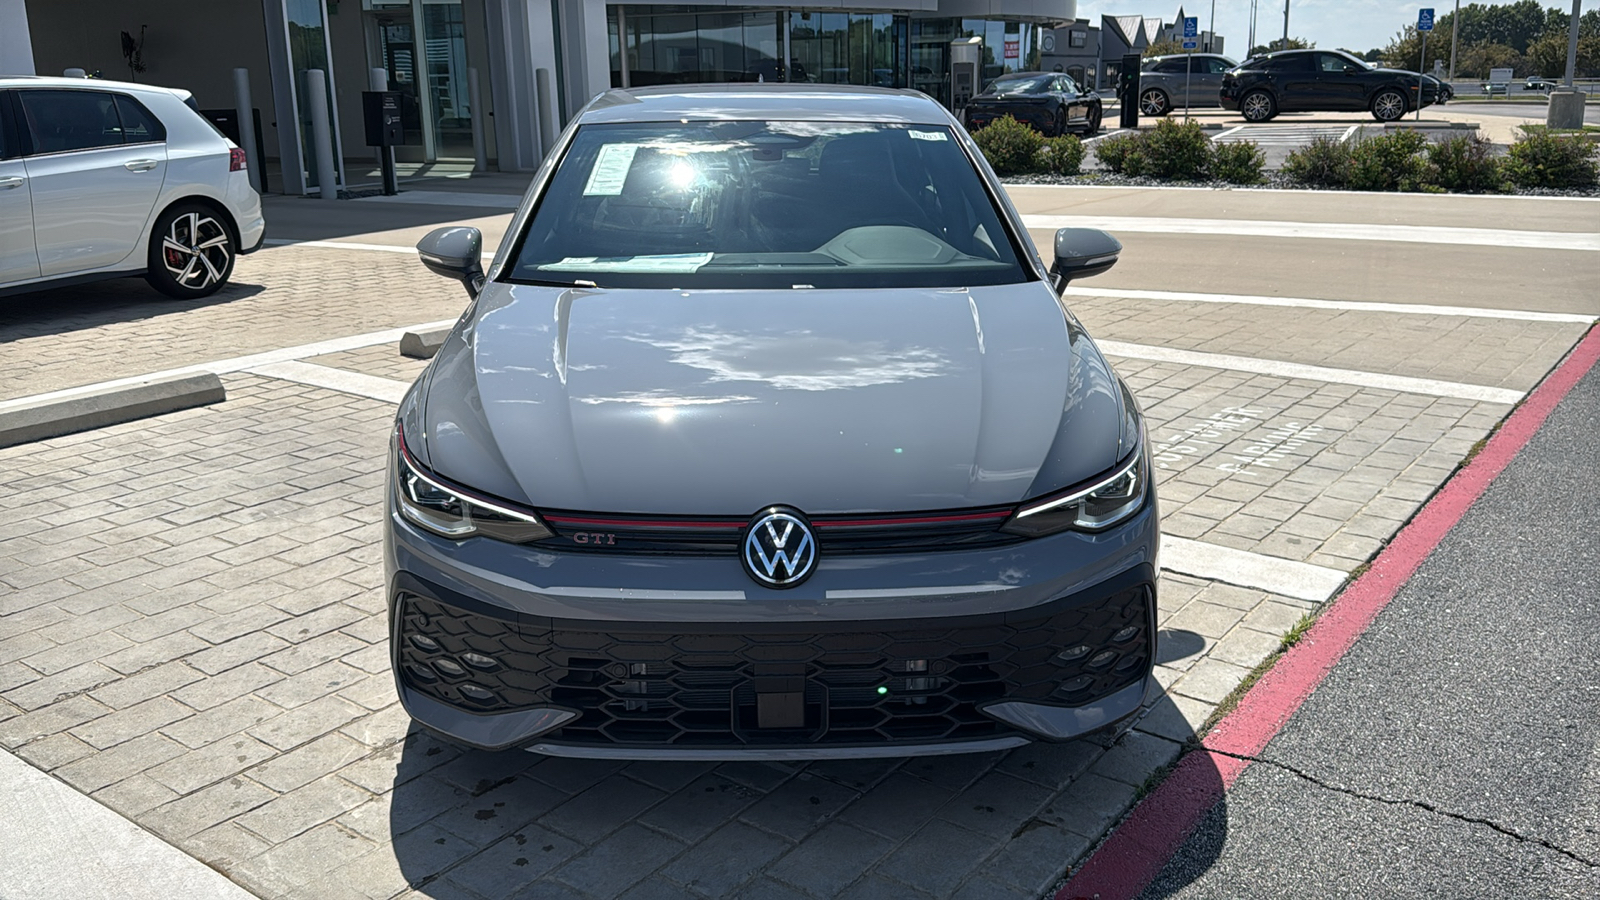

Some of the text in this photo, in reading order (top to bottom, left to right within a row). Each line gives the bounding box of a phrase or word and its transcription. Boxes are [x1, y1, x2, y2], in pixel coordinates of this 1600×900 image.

[1216, 422, 1323, 476] PARKING
[573, 532, 615, 545] GTI
[749, 518, 811, 578] VW
